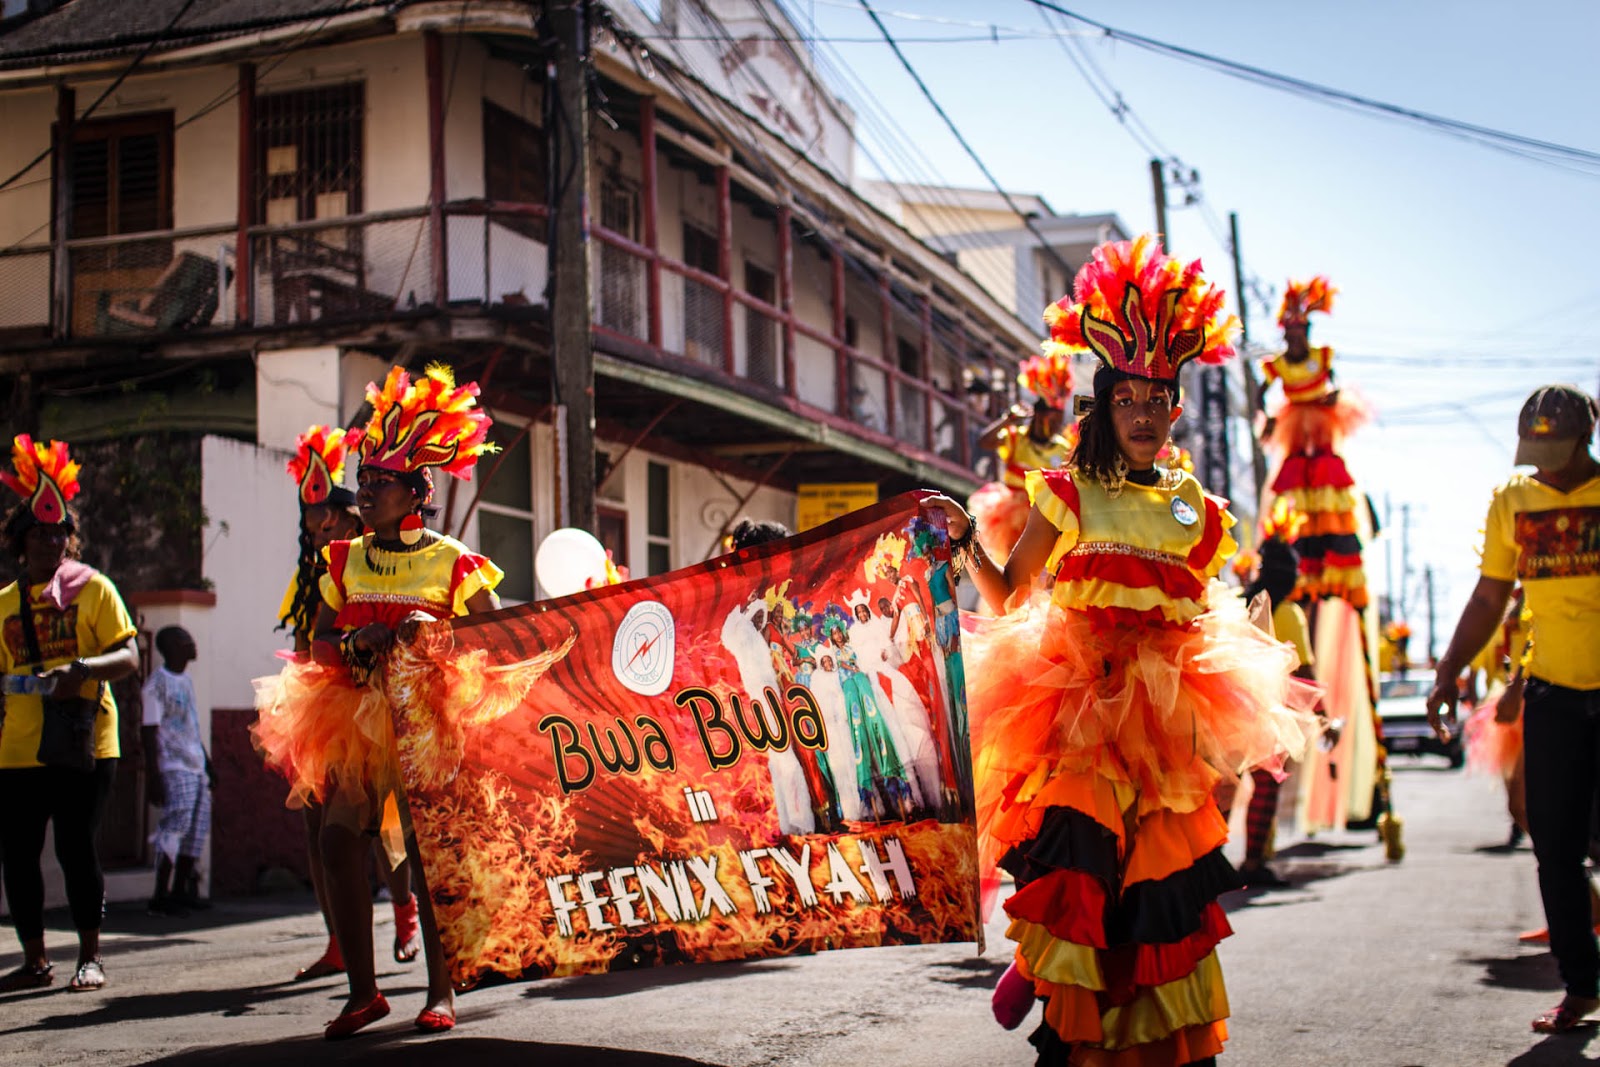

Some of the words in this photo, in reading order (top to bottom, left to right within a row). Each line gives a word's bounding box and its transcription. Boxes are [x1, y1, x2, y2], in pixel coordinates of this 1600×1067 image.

[538, 713, 677, 795] Bwa
[674, 684, 828, 771] Bwa
[683, 786, 718, 822] in
[545, 854, 738, 938] FEENIX
[739, 837, 917, 914] FYAH
